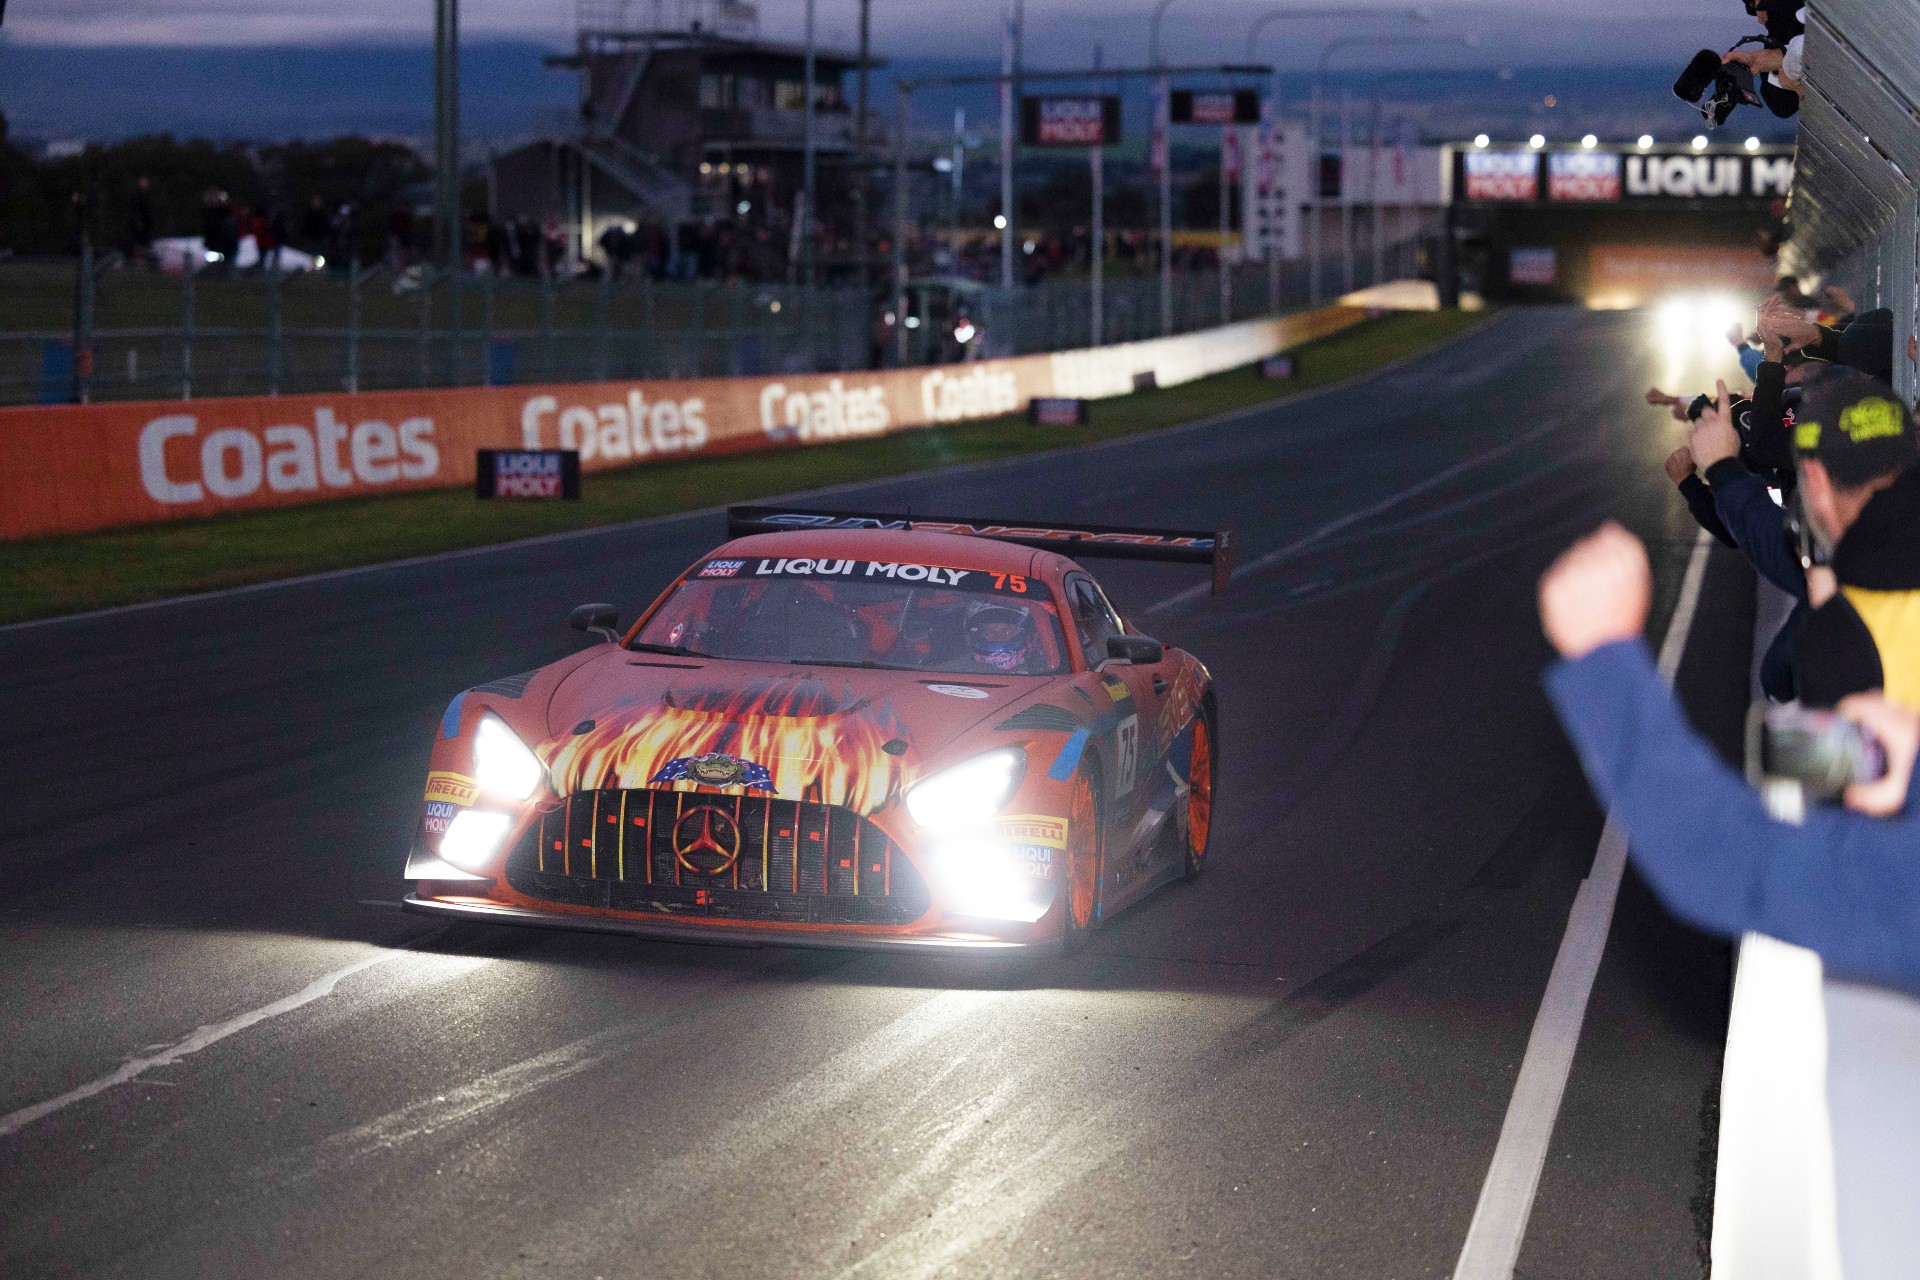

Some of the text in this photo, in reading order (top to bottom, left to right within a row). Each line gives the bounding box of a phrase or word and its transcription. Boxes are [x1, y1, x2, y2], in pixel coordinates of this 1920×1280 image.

[1627, 156, 1741, 196] LIQUI
[920, 366, 1019, 421] Coates
[760, 378, 891, 440] Coates
[521, 390, 709, 459] Coates
[138, 407, 440, 503] Coates
[496, 454, 559, 474] LIQUI
[497, 476, 559, 496] MOLY
[755, 558, 970, 586] LIQUI MOLY
[989, 571, 1027, 593] 75
[426, 776, 477, 799] PIRELLI
[427, 803, 454, 818] LIQUI
